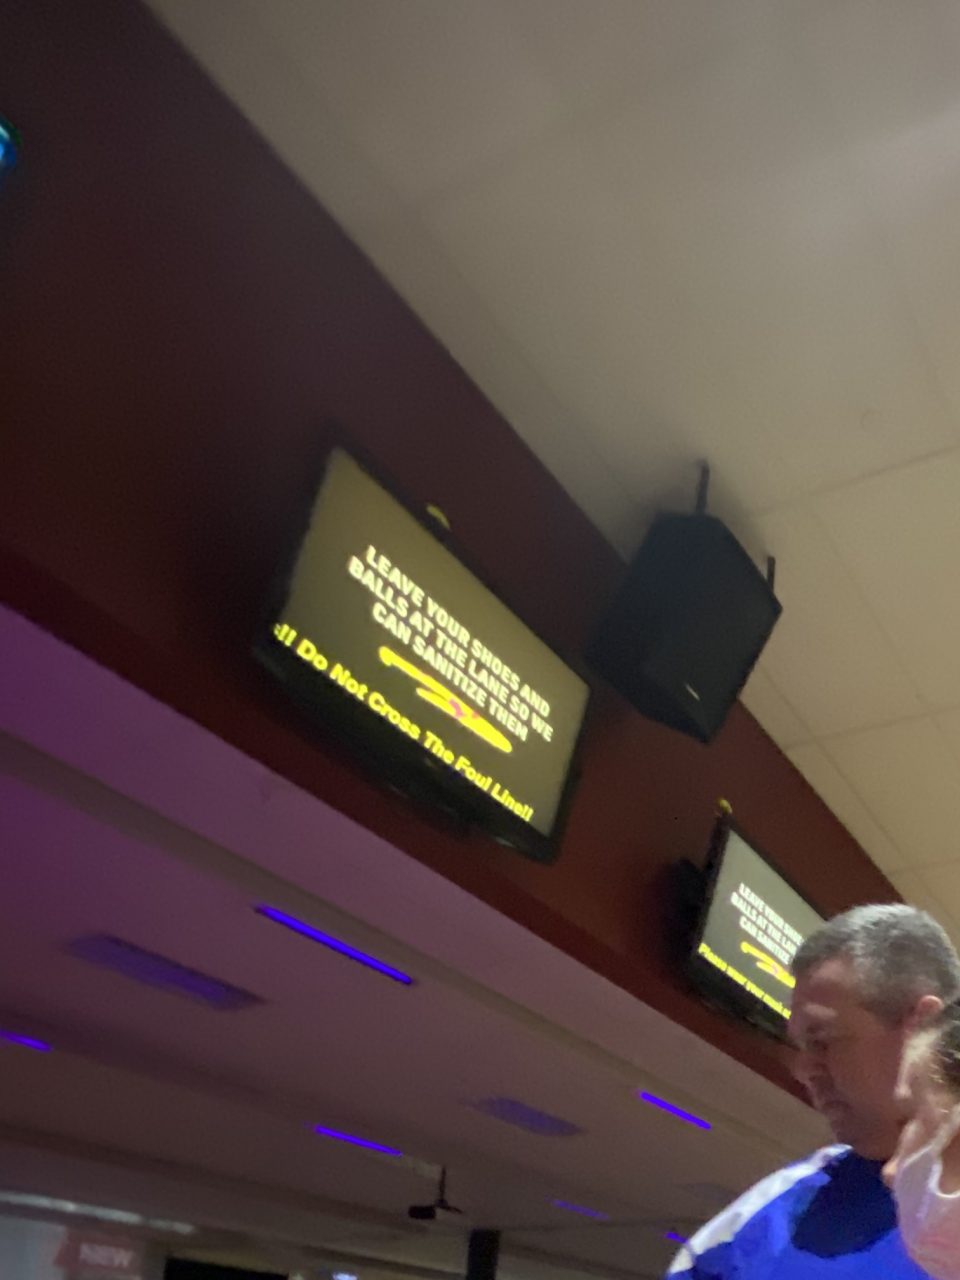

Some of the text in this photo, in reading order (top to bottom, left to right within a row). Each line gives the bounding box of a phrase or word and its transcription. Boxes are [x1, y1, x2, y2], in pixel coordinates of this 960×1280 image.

[348, 555, 554, 742] BALLS AT THE LANE SO WE
[366, 544, 551, 718] LEAVE YOUR SHOES AND
[372, 602, 529, 741] CAN SANITIZE THEM
[296, 638, 329, 671] Do
[329, 663, 368, 701] Not
[368, 691, 421, 740] Cross
[424, 730, 455, 765] The
[455, 755, 493, 792] Foul
[730, 891, 758, 922] BALLS
